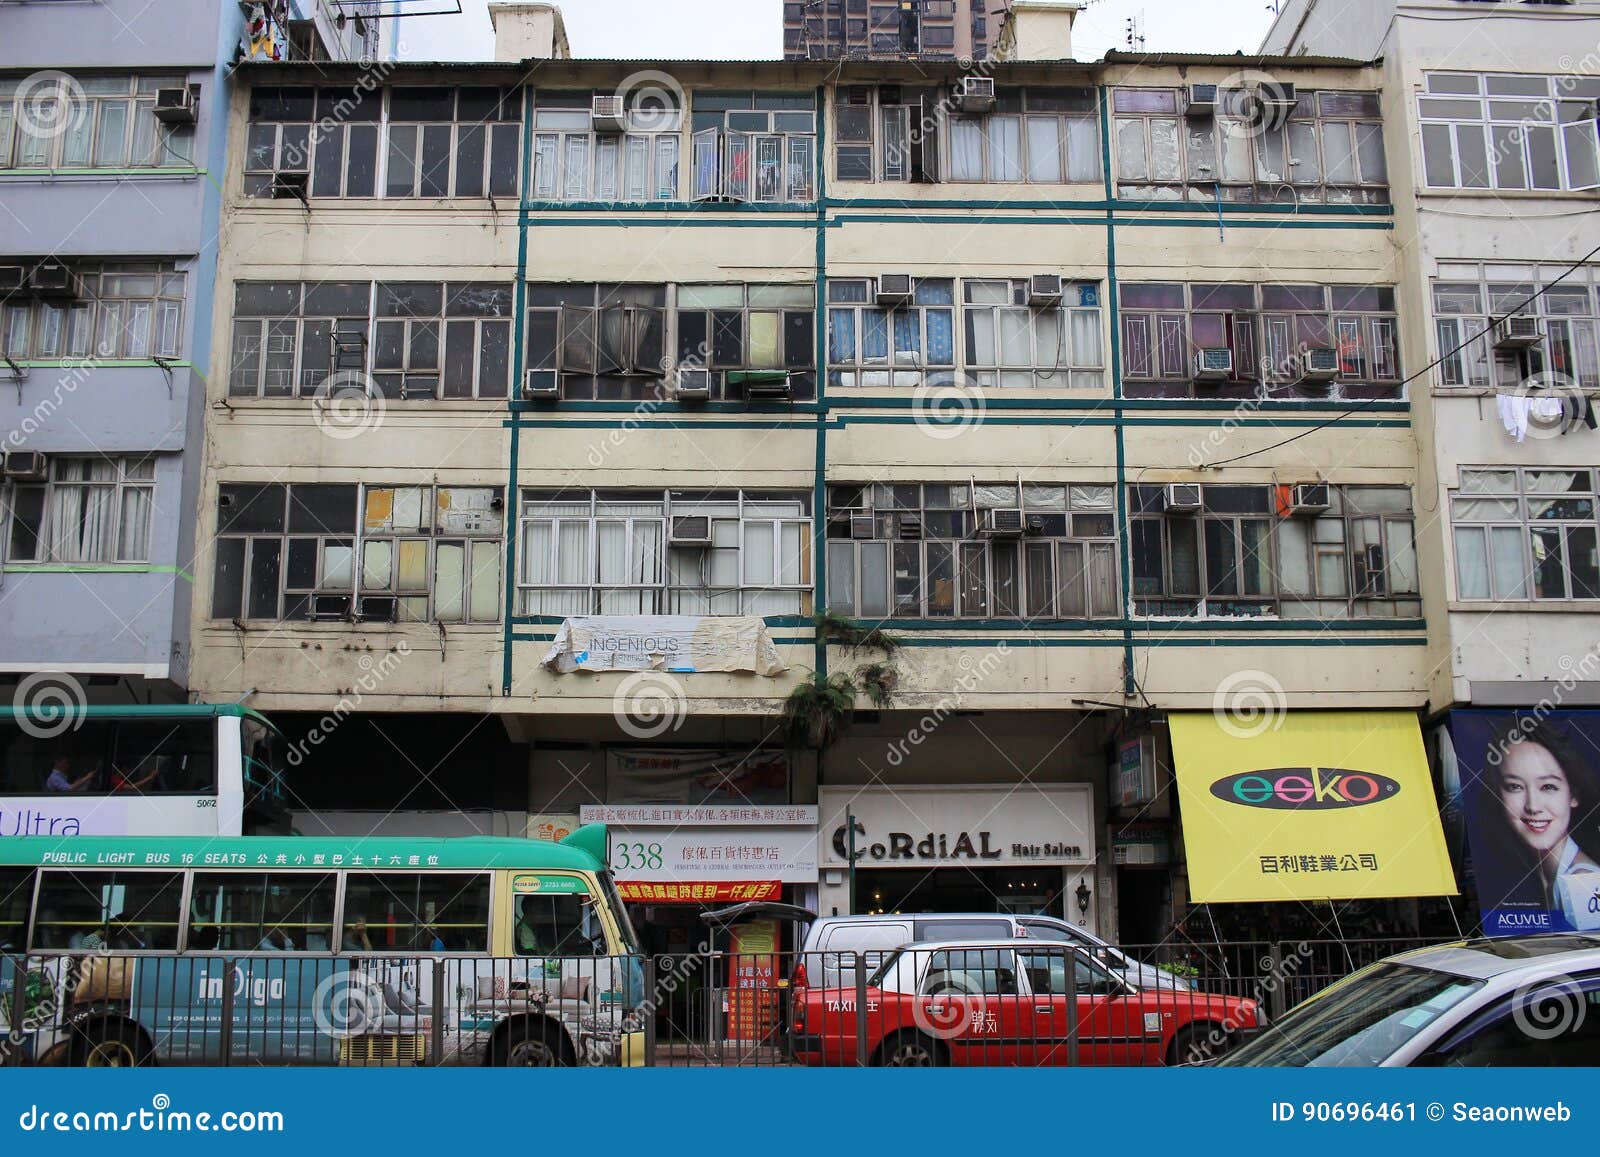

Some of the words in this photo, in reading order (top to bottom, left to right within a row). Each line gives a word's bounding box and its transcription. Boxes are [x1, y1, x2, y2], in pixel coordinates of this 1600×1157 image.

[590, 638, 678, 651] INGENIOUS
[1233, 767, 1379, 802] esko
[197, 800, 216, 808] 5062
[0, 810, 80, 836] Ultra
[1012, 843, 1040, 856] Hair
[1044, 842, 1081, 856] Salon
[42, 852, 87, 864] PUBLIC
[98, 852, 135, 864] LIGHT
[145, 852, 171, 864] BUS
[181, 853, 194, 864] 16
[204, 853, 247, 864] SEATS
[615, 842, 663, 870] 338
[1259, 853, 1378, 874] 百利鞋業公司
[1498, 913, 1549, 925] ACUVUE
[826, 1000, 851, 1012] TAXI
[972, 1021, 997, 1033] TAXI
